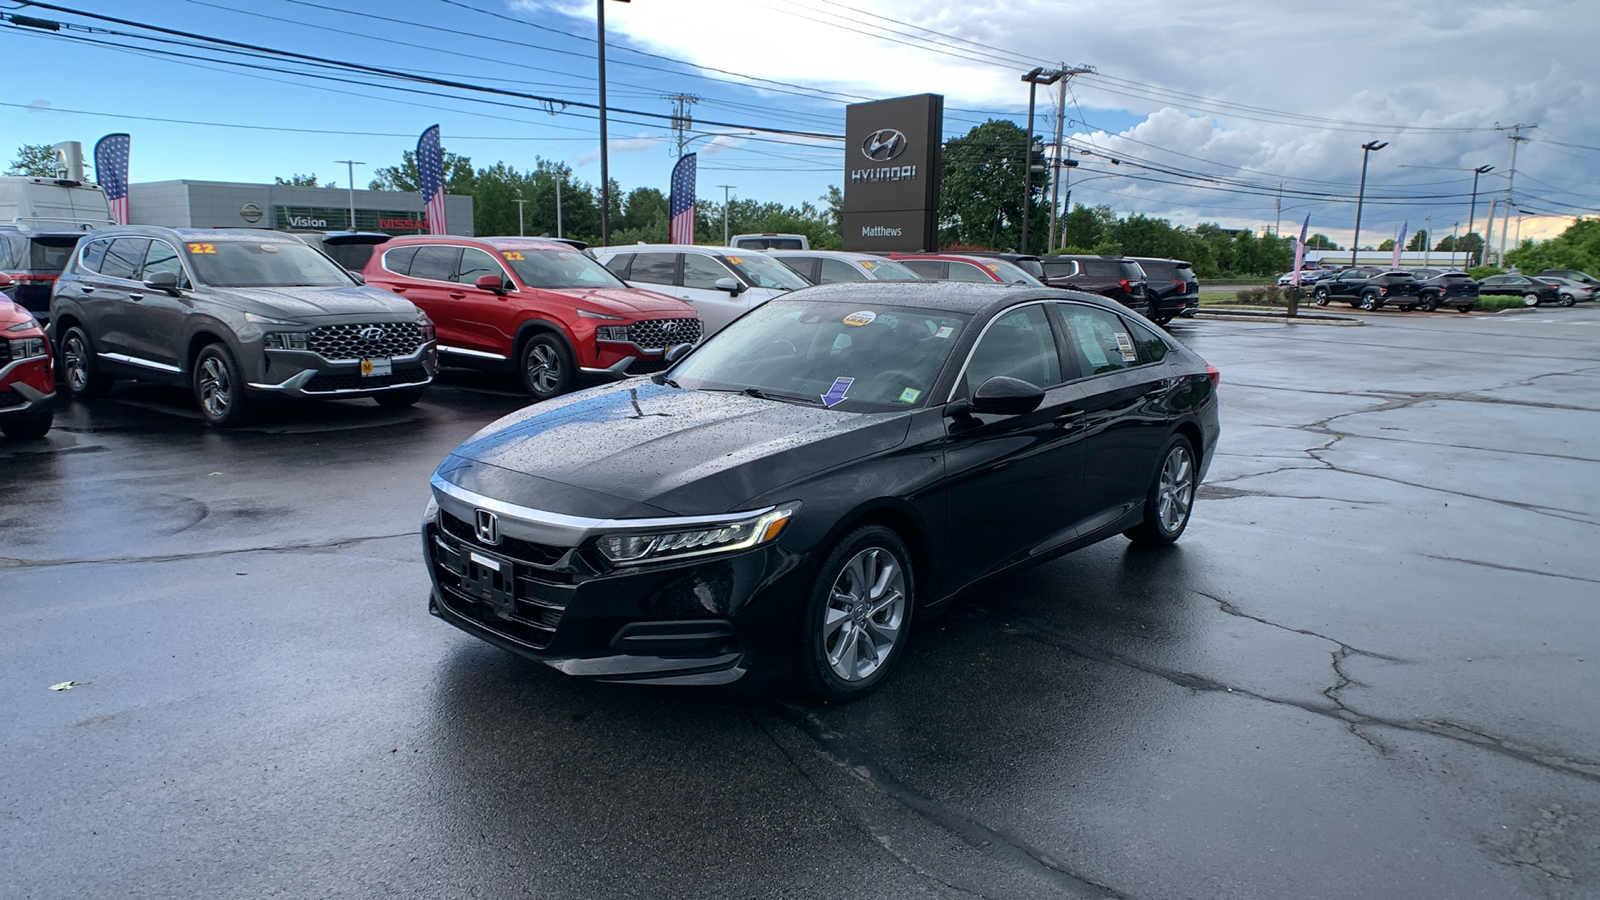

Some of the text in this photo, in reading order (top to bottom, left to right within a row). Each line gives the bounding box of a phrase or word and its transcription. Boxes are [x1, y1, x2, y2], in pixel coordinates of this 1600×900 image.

[852, 165, 916, 183] HYUNDAI
[289, 216, 327, 227] Vision
[862, 226, 902, 236] Matthews
[189, 243, 217, 253] 22
[502, 251, 526, 260] 22
